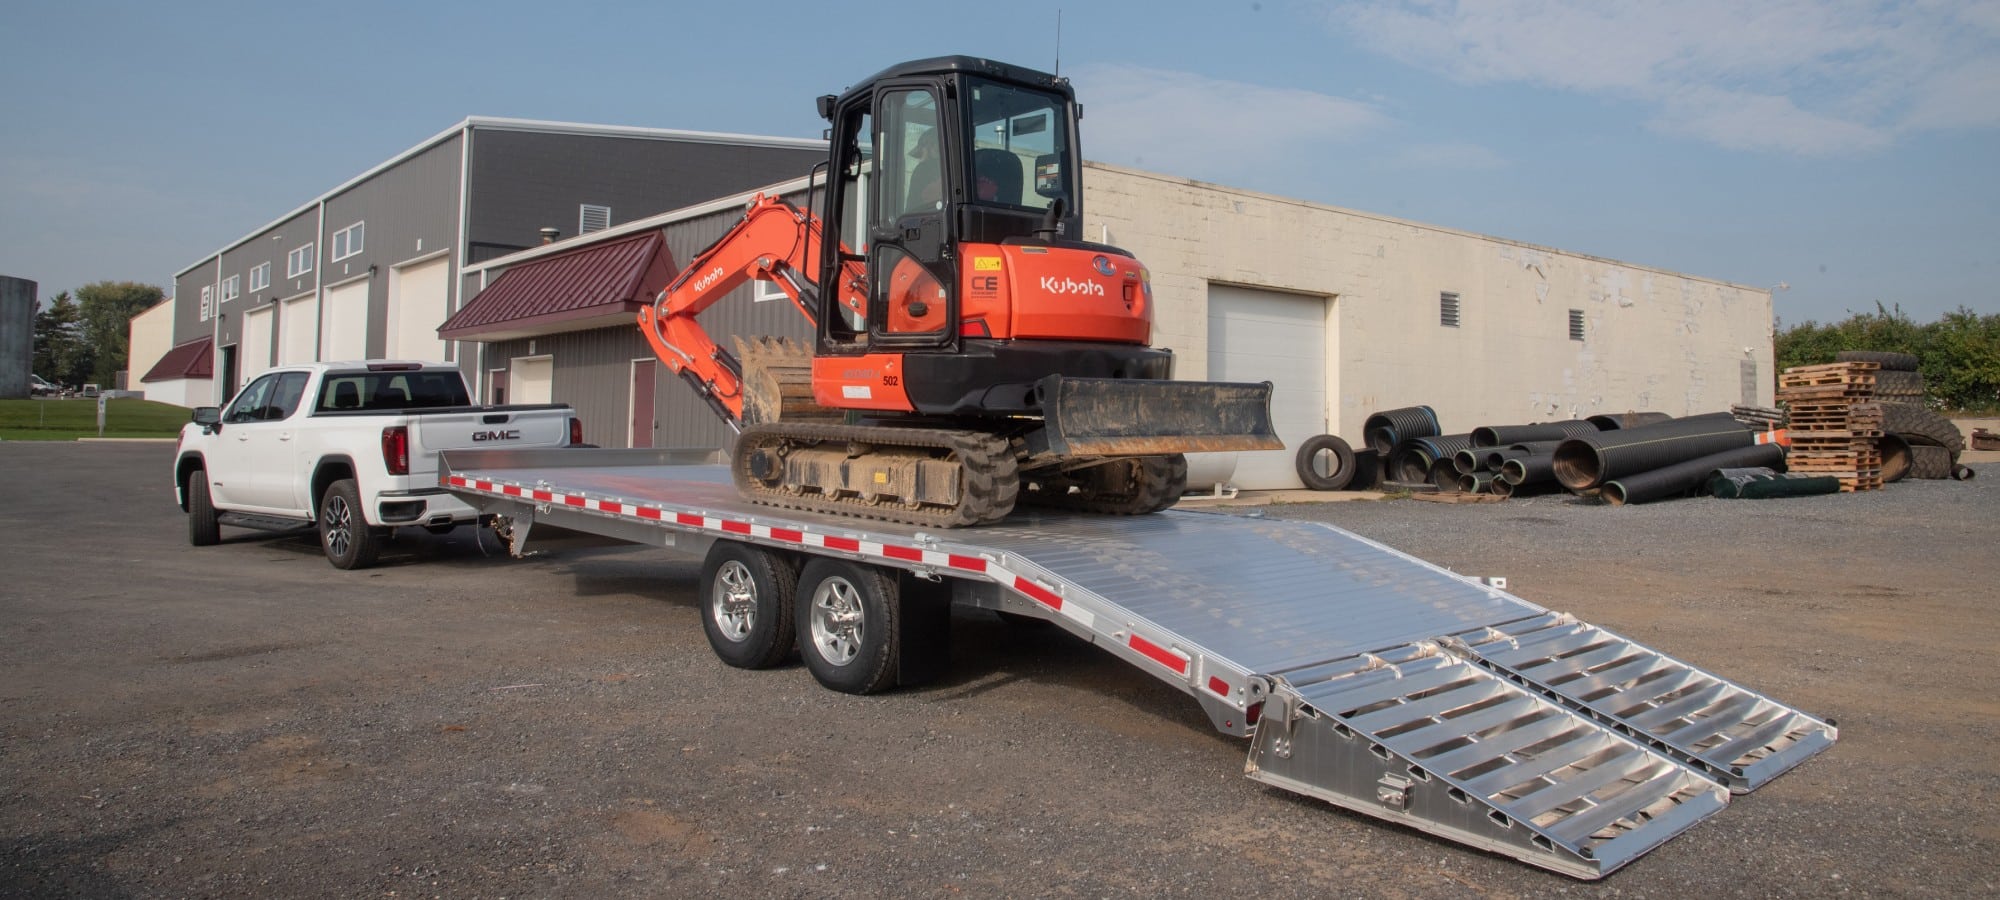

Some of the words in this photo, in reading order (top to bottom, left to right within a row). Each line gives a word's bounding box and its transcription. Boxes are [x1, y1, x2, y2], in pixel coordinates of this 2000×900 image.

[694, 266, 724, 292] Kubota
[1040, 276, 1104, 296] Kubota
[883, 375, 898, 386] 502
[472, 430, 520, 441] GMC
